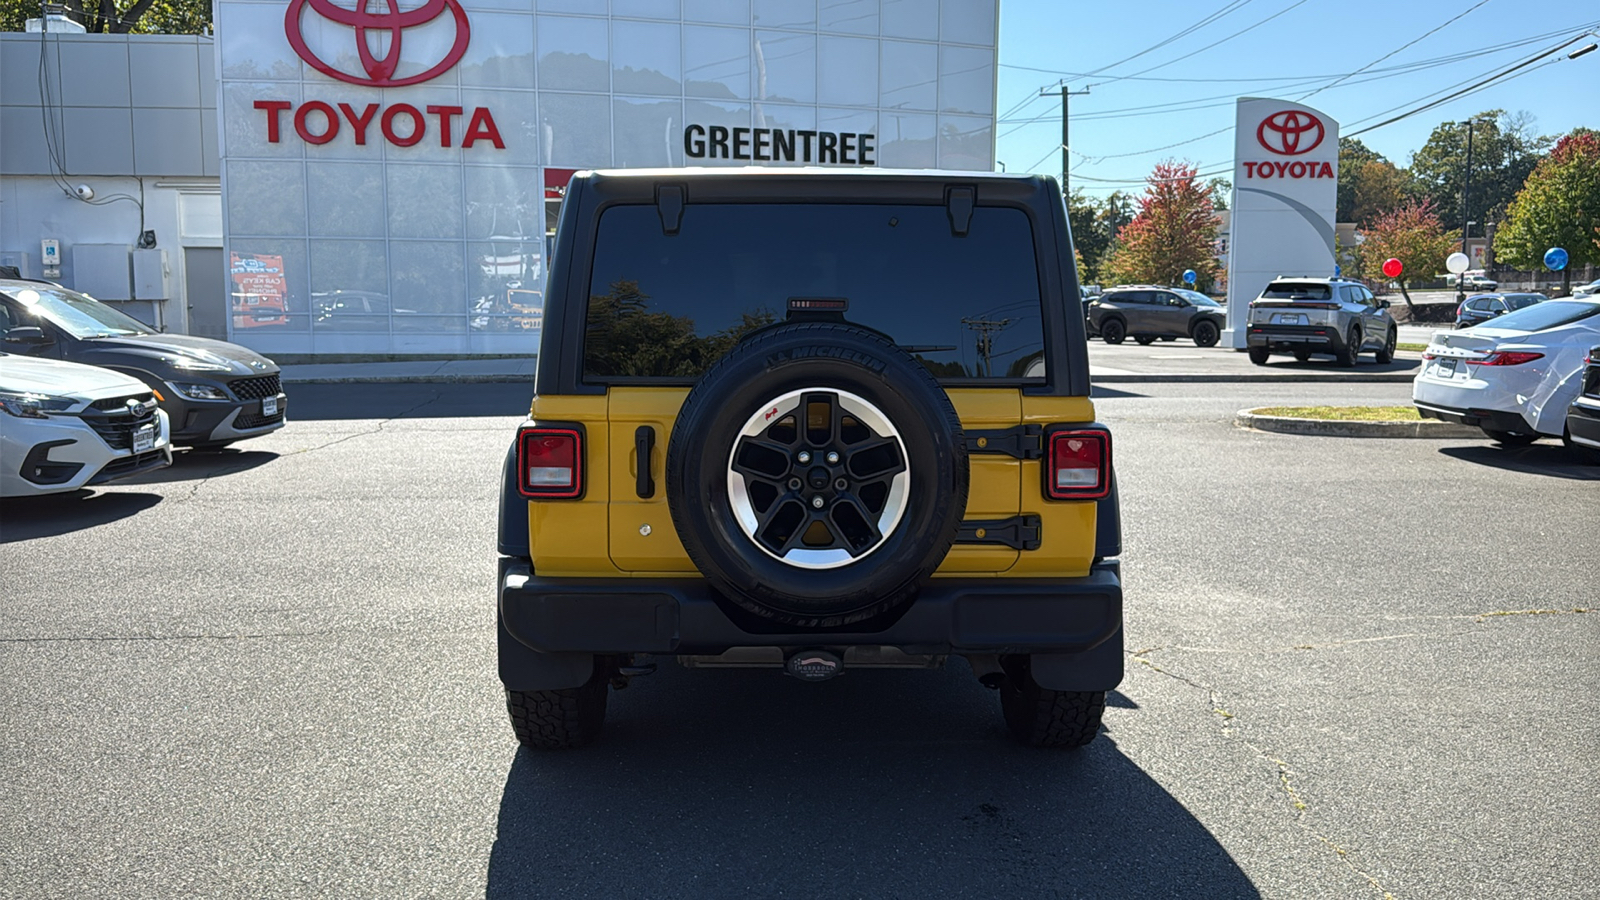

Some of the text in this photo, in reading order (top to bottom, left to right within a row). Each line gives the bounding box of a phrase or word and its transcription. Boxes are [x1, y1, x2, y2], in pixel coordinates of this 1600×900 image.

[253, 100, 506, 149] TOYOTA
[684, 124, 875, 165] GREENTREE
[1242, 161, 1335, 179] TOYOTA
[791, 345, 886, 372] MICHELIN
